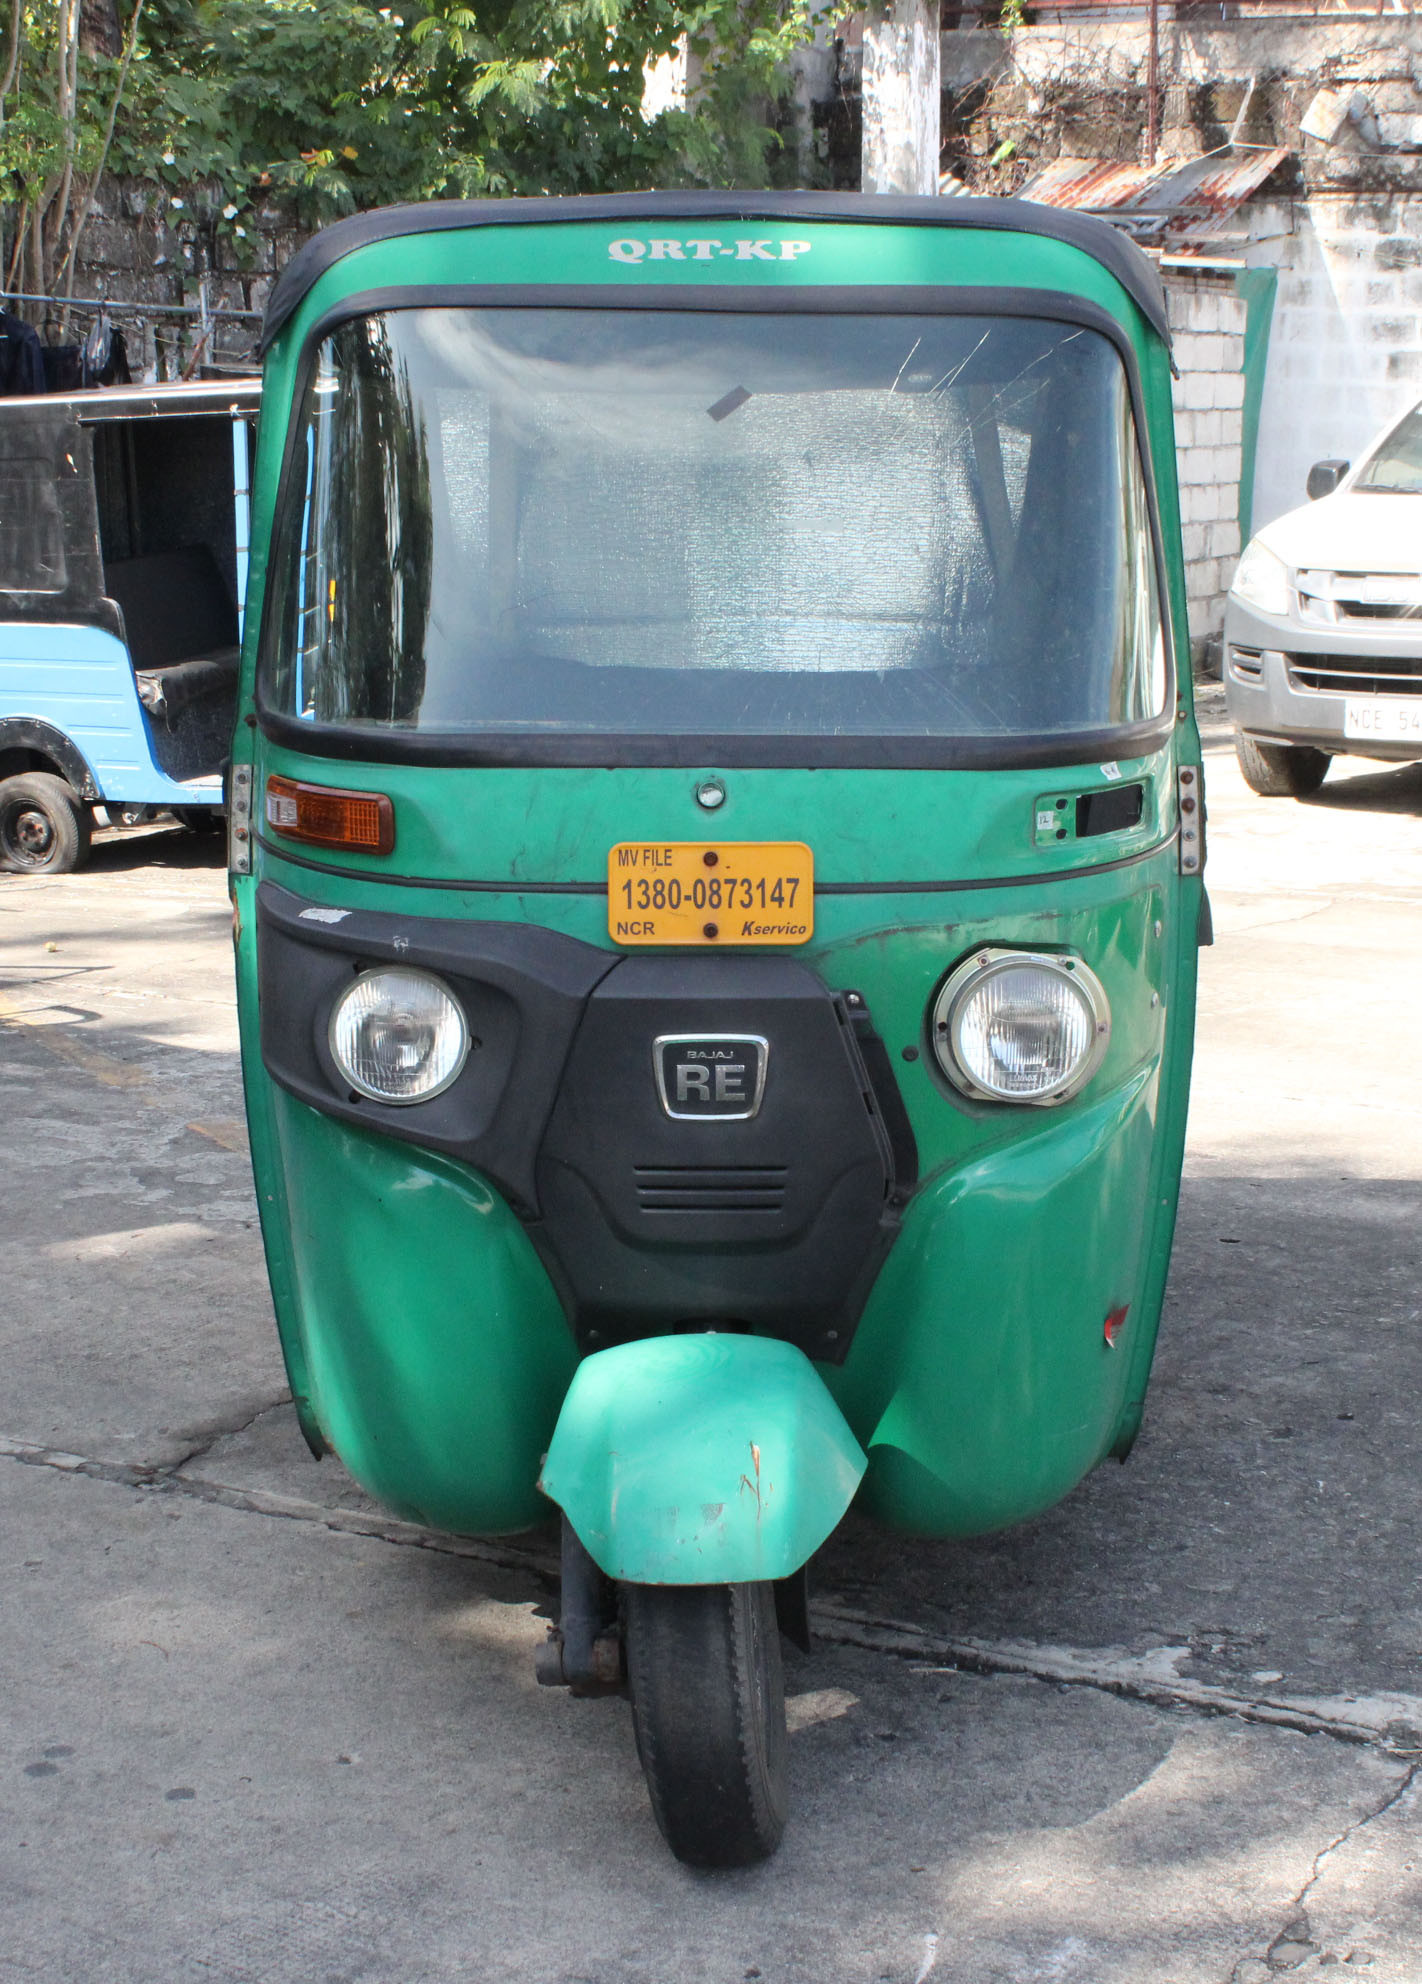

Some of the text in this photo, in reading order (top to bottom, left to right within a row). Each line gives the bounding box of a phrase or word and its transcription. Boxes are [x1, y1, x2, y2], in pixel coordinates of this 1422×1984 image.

[608, 239, 812, 264] QRT-KP
[1349, 709, 1384, 729] NCE
[618, 849, 672, 866] MV FILE
[622, 877, 800, 910] 1380-0873147
[616, 920, 807, 936] NCR Kservico
[687, 1051, 734, 1059] BAJAJ
[676, 1064, 746, 1101] RE
